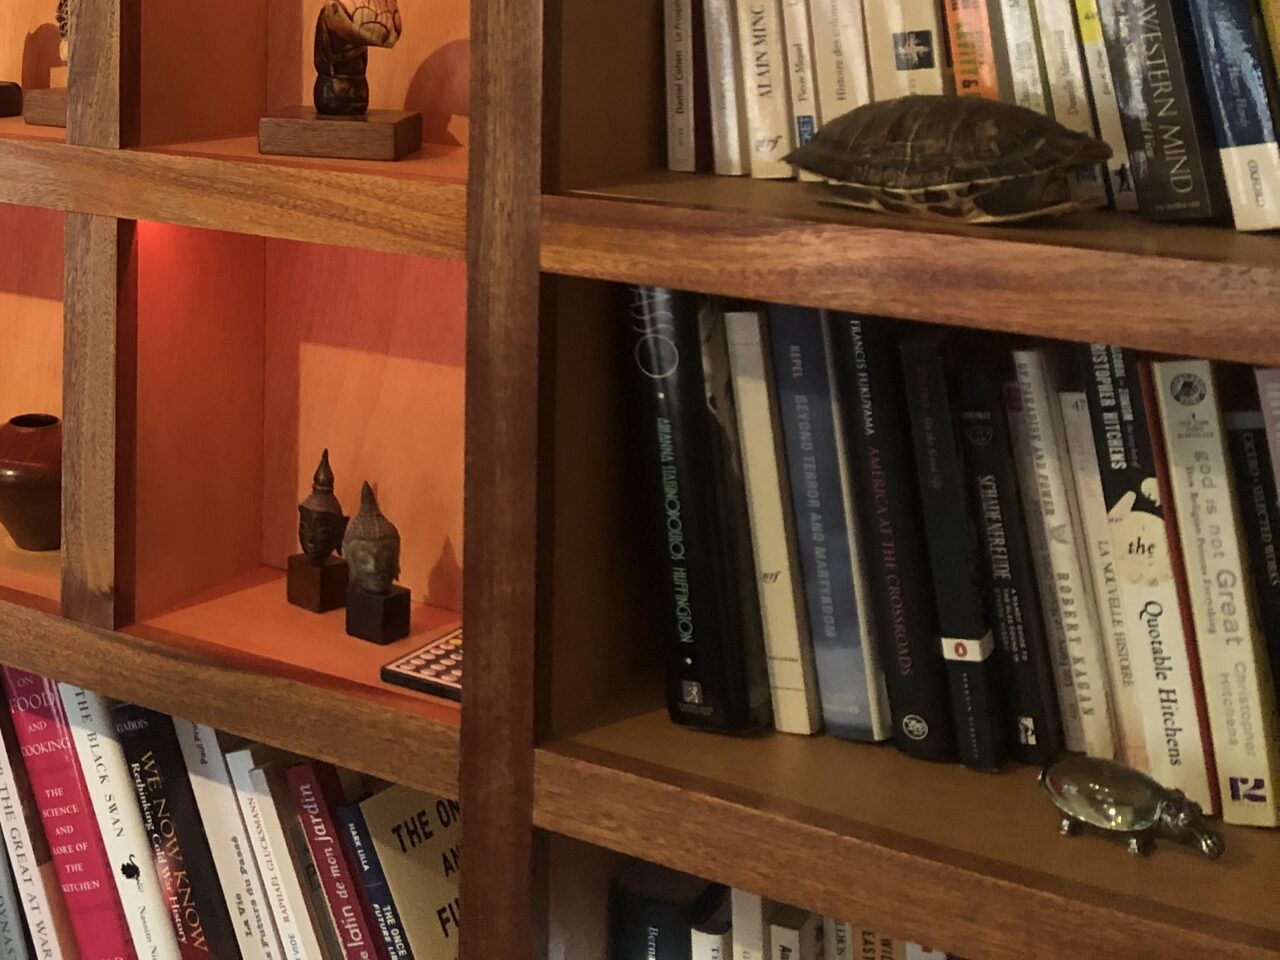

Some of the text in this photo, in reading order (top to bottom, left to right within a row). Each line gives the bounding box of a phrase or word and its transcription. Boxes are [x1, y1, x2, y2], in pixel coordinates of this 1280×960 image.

[751, 2, 772, 99] ALAIN MINC
[834, 60, 847, 102] Histoire
[1137, 4, 1177, 117] WESTERN
[1157, 124, 1194, 194] MIND
[849, 319, 876, 436] FRANCIS FUKUYAMA
[1031, 445, 1047, 471] AND
[1101, 411, 1127, 471] HITCHENS
[656, 416, 695, 644] ARIANNA HUFFINGTON
[793, 394, 838, 638] BEYOND TERROR AND MARTYRDOM
[976, 474, 1011, 581] SCHADENFREUDE
[867, 446, 913, 677] AMERICA AT THE CROSSROADS
[1128, 536, 1156, 557] the
[1193, 450, 1245, 648] god is not Great
[1055, 571, 1082, 646] ROBERT
[1072, 655, 1096, 717] KAGAN
[1101, 562, 1134, 689] NOUVELLE HISTOIRE
[10, 692, 55, 715] FOOD
[1140, 600, 1183, 768] Quotable Hitchens
[1219, 672, 1240, 747] Hitchens
[1233, 660, 1259, 759] Christopher
[27, 720, 47, 733] AND
[196, 744, 208, 765] Paul
[74, 688, 126, 839] THE BLACK SWAN
[42, 803, 79, 818] SCIENCE
[44, 787, 64, 798] THE
[10, 827, 35, 883] GREAT
[54, 824, 74, 836] AND
[74, 841, 89, 853] OF
[130, 762, 187, 944] Rethinking Cold History
[139, 750, 209, 953] WE NOW KNOW
[248, 796, 275, 872] GLUCKSMANN
[348, 823, 370, 872] MARK LILLA
[391, 809, 434, 854] THE
[64, 862, 85, 873] THE
[230, 835, 269, 947] Futurs du Passé
[299, 783, 364, 947] latin de mon jardin
[26, 892, 43, 917] AT
[138, 905, 153, 943] Nassim
[234, 892, 253, 937] La Vie
[373, 903, 392, 942] FUTURE
[382, 905, 406, 957] THE ONCE
[33, 919, 57, 960] WAR
[287, 933, 300, 956] VIDE
